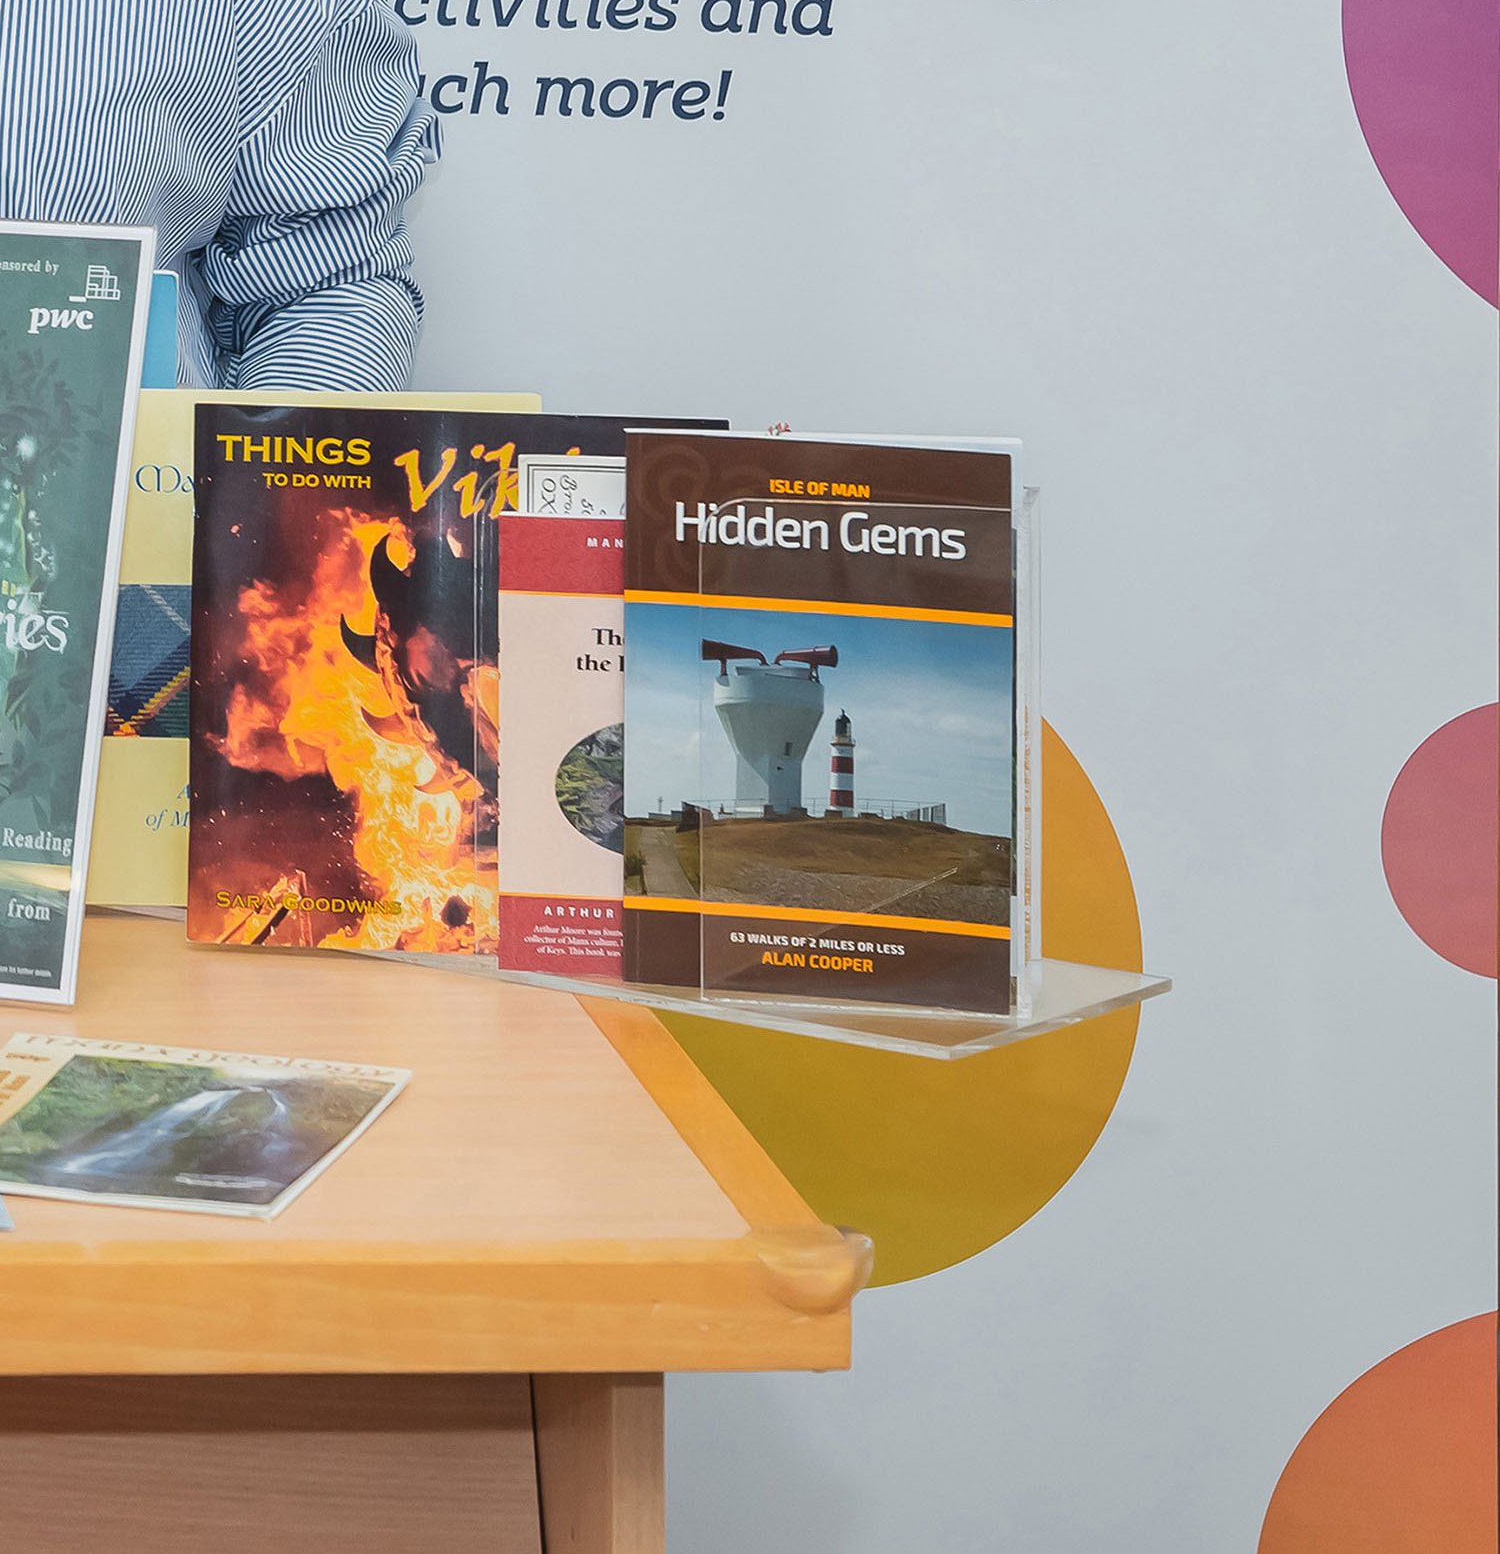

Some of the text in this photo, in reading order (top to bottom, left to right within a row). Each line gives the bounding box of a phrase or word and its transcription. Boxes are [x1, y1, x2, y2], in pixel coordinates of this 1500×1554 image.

[417, 61, 730, 122] ch more!
[45, 261, 60, 275] by
[27, 306, 94, 334] pwc
[216, 434, 372, 466] THINGS
[262, 472, 372, 489] TO DO WITH
[769, 478, 871, 498] ISLE OF MAN
[675, 501, 967, 560] Hidden Gems
[586, 537, 624, 549] MAN
[591, 627, 624, 646] Th
[576, 654, 612, 672] the
[145, 809, 168, 832] of
[2, 828, 73, 857] Reading
[7, 898, 51, 922] from
[544, 906, 615, 919] ARTHUR
[730, 931, 905, 956] 63 WALKS OF 2 MILES OR LESS
[761, 951, 873, 973] ALAN COOPER
